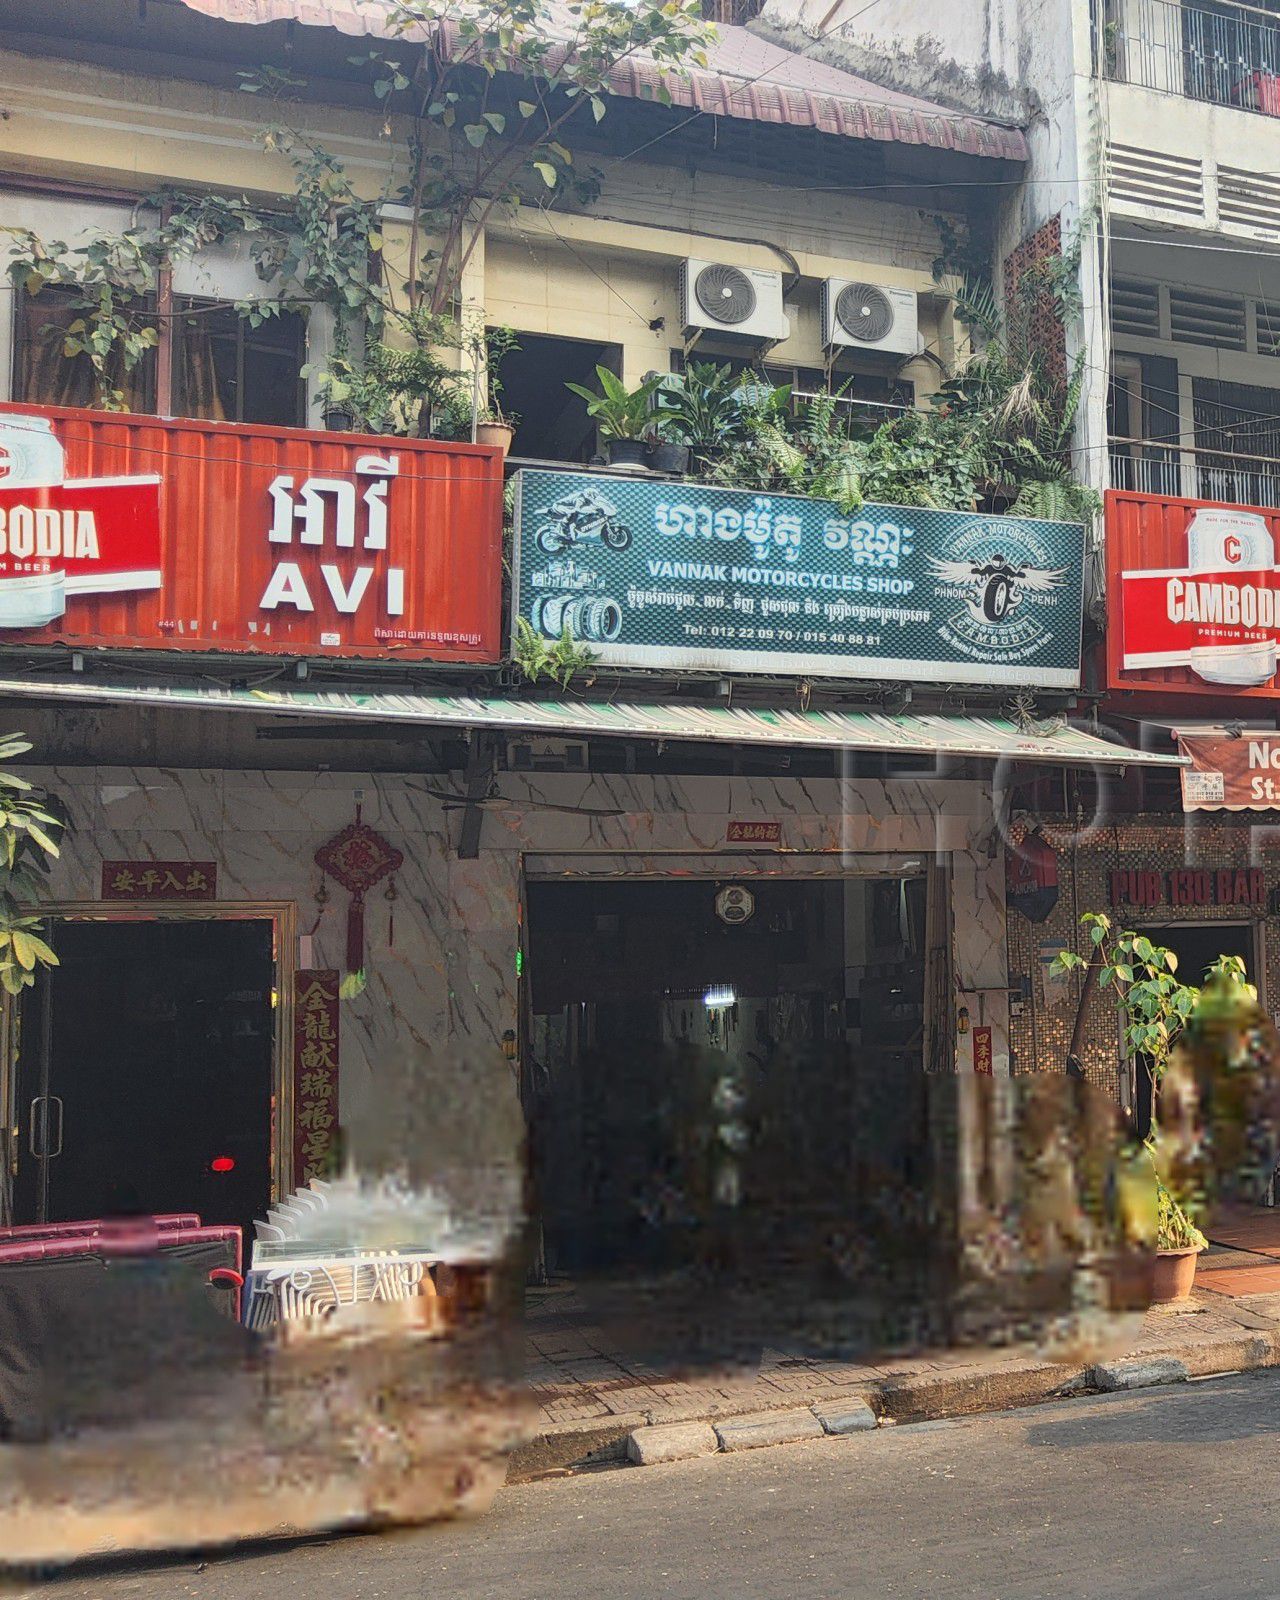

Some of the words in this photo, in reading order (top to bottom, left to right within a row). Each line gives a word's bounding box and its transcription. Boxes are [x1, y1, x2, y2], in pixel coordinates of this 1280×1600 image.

[14, 562, 51, 572] BEER
[647, 560, 729, 582] VANNAK
[731, 566, 863, 592] MOTORCYCLES
[867, 577, 915, 596] SHOP
[259, 563, 405, 616] AVI
[934, 587, 967, 600] PHNOM
[1031, 595, 1058, 606] PENH
[683, 624, 707, 636] Tel:
[711, 626, 736, 638] 012
[739, 627, 756, 639] 22
[758, 628, 774, 640] 09
[777, 629, 793, 641] 70
[803, 630, 827, 643] 015
[830, 632, 845, 643] 40
[848, 633, 865, 645] 88
[866, 634, 881, 646] 81
[956, 620, 1038, 645] CAMBODIA
[1198, 628, 1241, 638] PREMIUM
[1244, 632, 1268, 640] BEER
[1250, 776, 1280, 800] St.
[1110, 870, 1161, 906] PUB
[1168, 870, 1211, 905] 130
[1217, 868, 1265, 905] BAR
